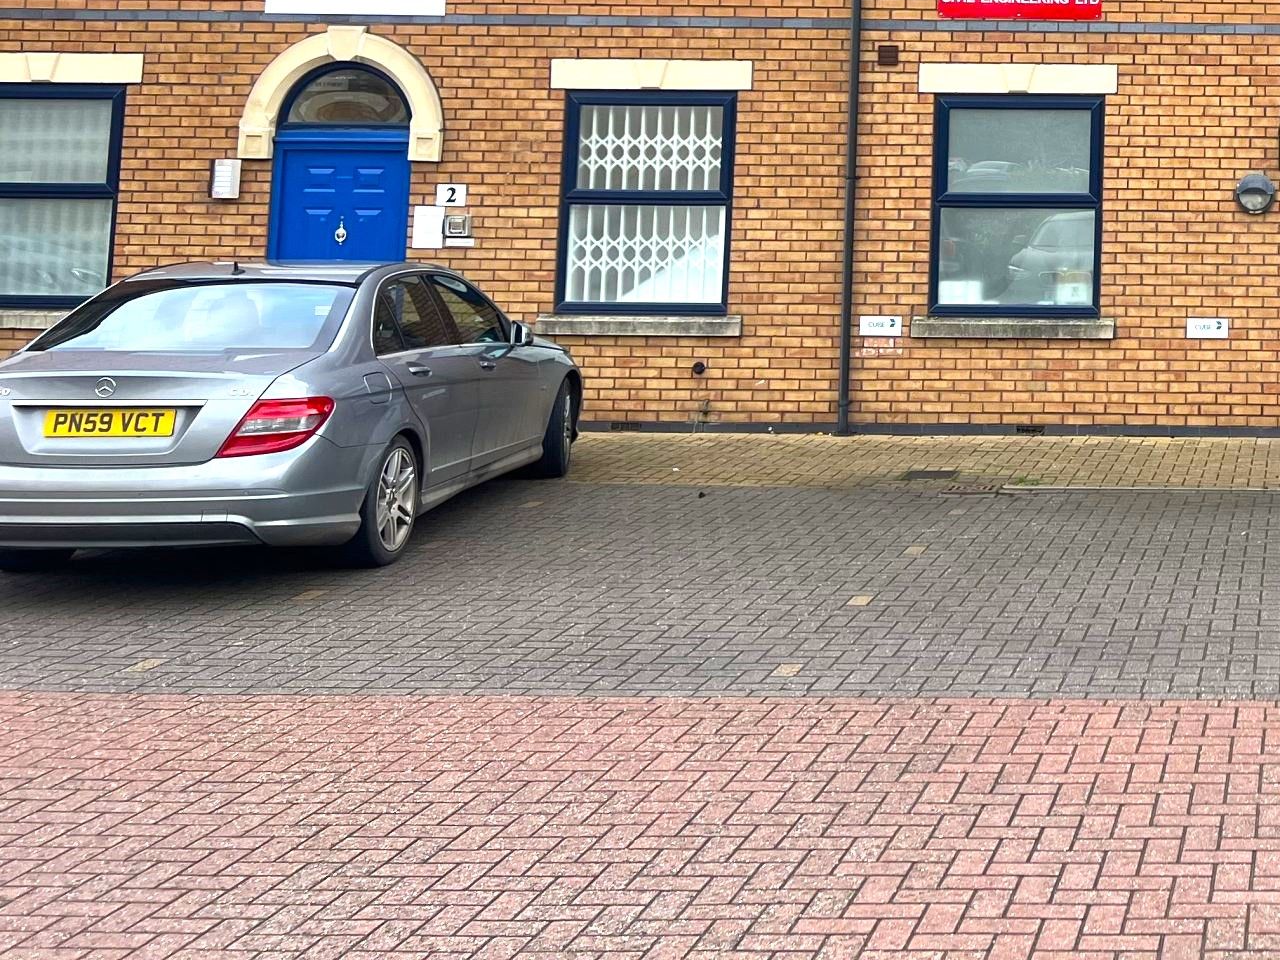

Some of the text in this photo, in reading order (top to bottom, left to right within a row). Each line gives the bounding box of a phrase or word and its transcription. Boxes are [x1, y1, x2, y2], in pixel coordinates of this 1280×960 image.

[445, 187, 457, 203] 2
[53, 413, 165, 433] PN59 VCT
